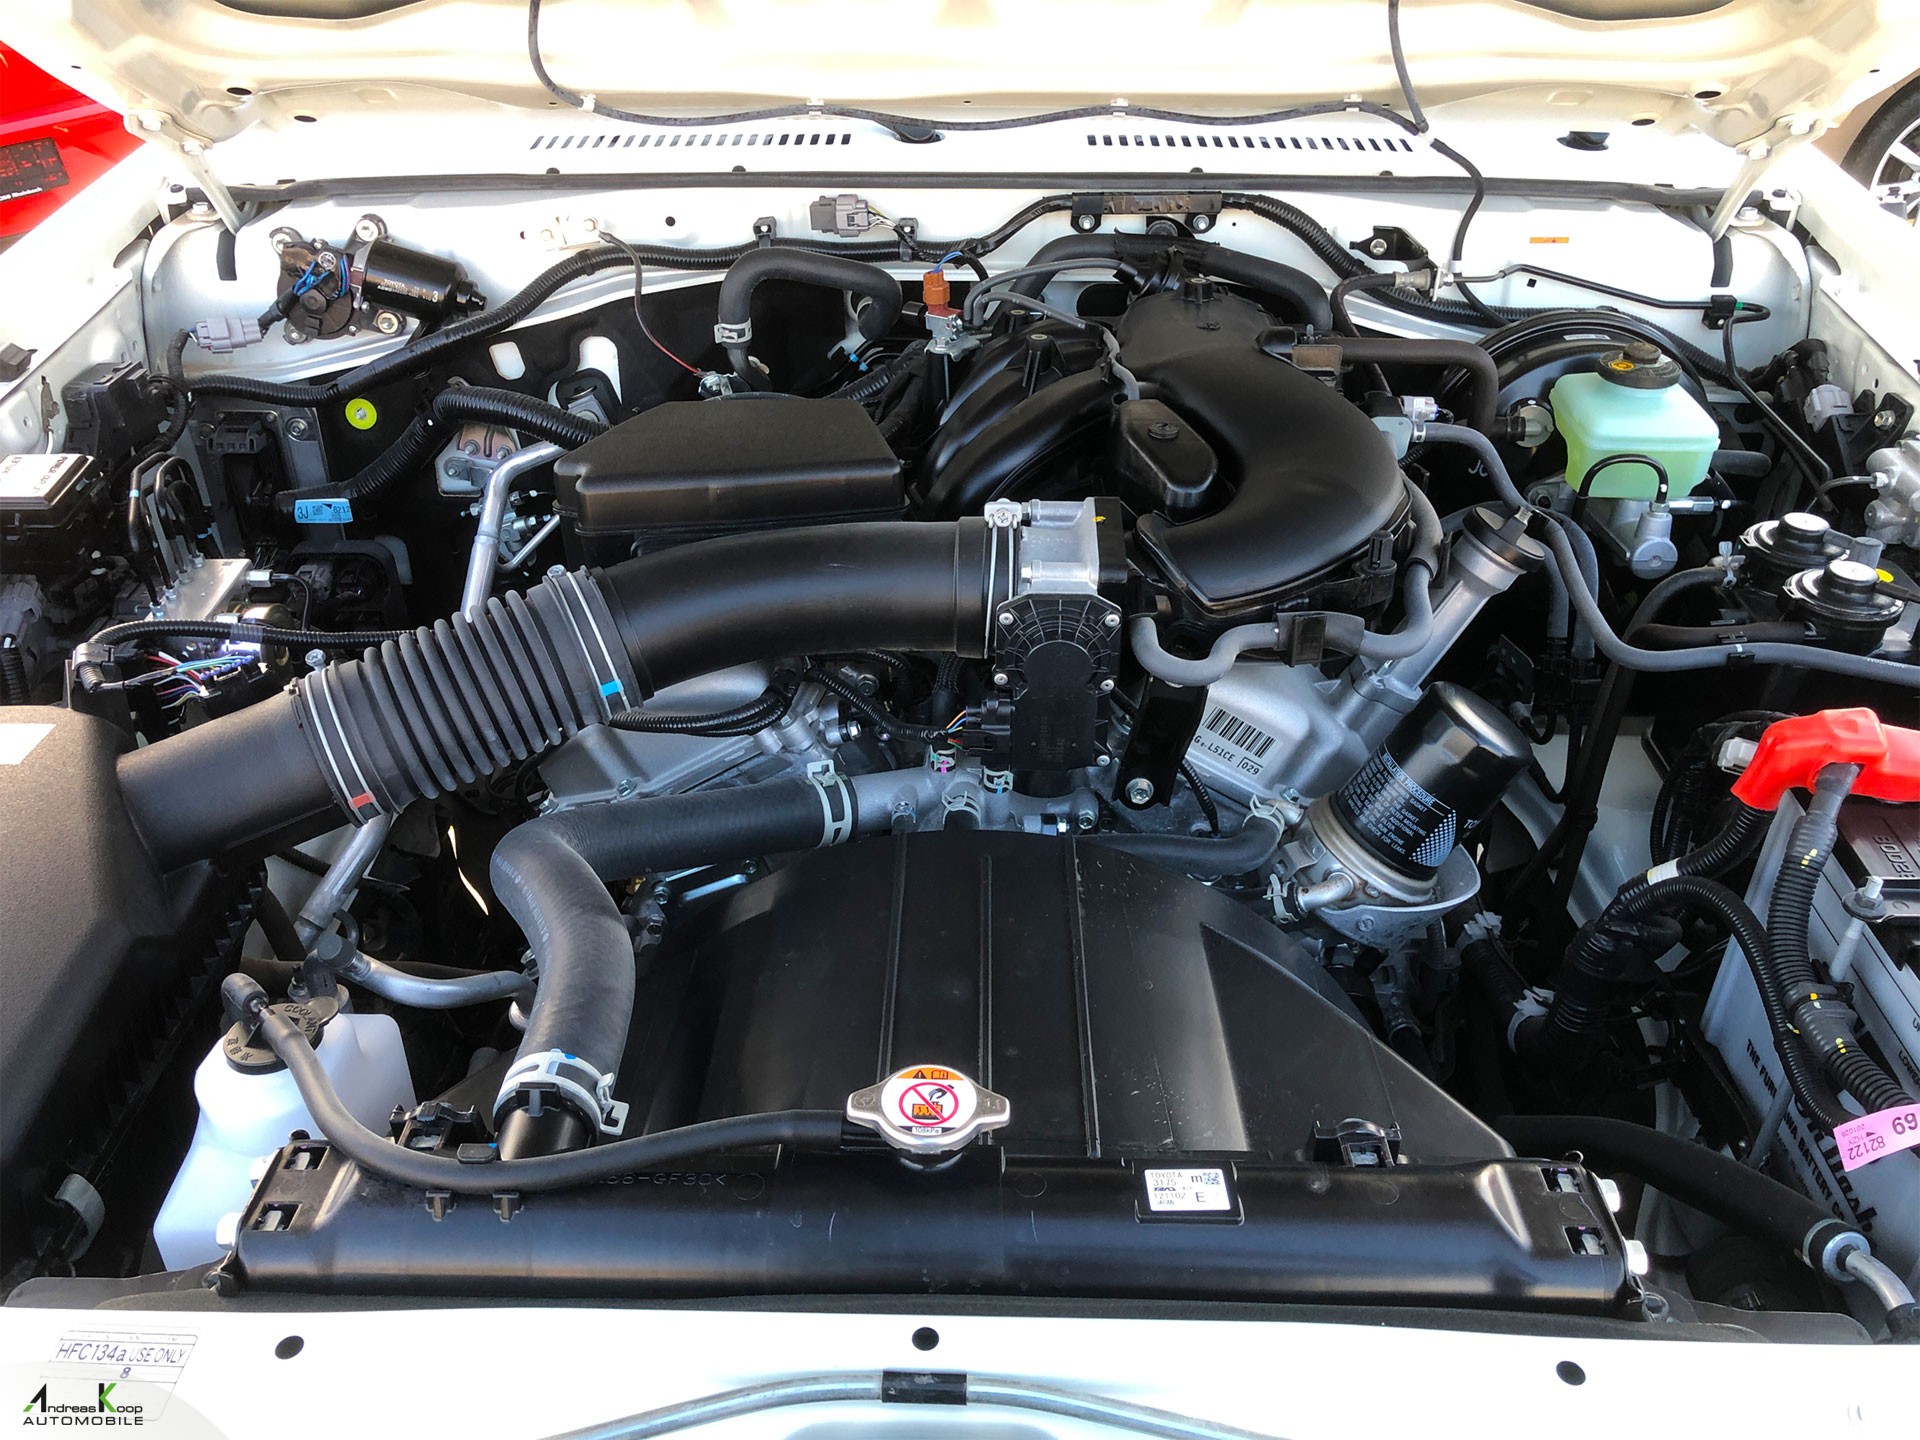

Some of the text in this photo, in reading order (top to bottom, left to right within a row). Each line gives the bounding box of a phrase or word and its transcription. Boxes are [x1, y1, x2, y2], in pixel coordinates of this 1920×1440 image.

[384, 279, 406, 288] TOYOTA
[432, 291, 439, 303] 3
[297, 505, 309, 519] 3J
[1241, 761, 1260, 775] 029
[1403, 777, 1436, 806] PROCEDURE
[1388, 806, 1404, 820] FILTER
[1408, 797, 1428, 813] GASKET
[1400, 807, 1419, 823] GASKET
[1366, 821, 1382, 837] CHECK
[1380, 833, 1392, 845] FOR
[1388, 815, 1415, 837] ADDITIONAL
[284, 1004, 316, 1034] COOLANT
[1746, 1038, 1761, 1069] THE
[1797, 1138, 1833, 1200] BATTERY
[1892, 1113, 1918, 1136] 69
[1847, 1136, 1886, 1160] 82122
[1153, 1179, 1177, 1187] 3175
[55, 1342, 187, 1364] HFC134a USE ONLY
[120, 1366, 132, 1379] 8
